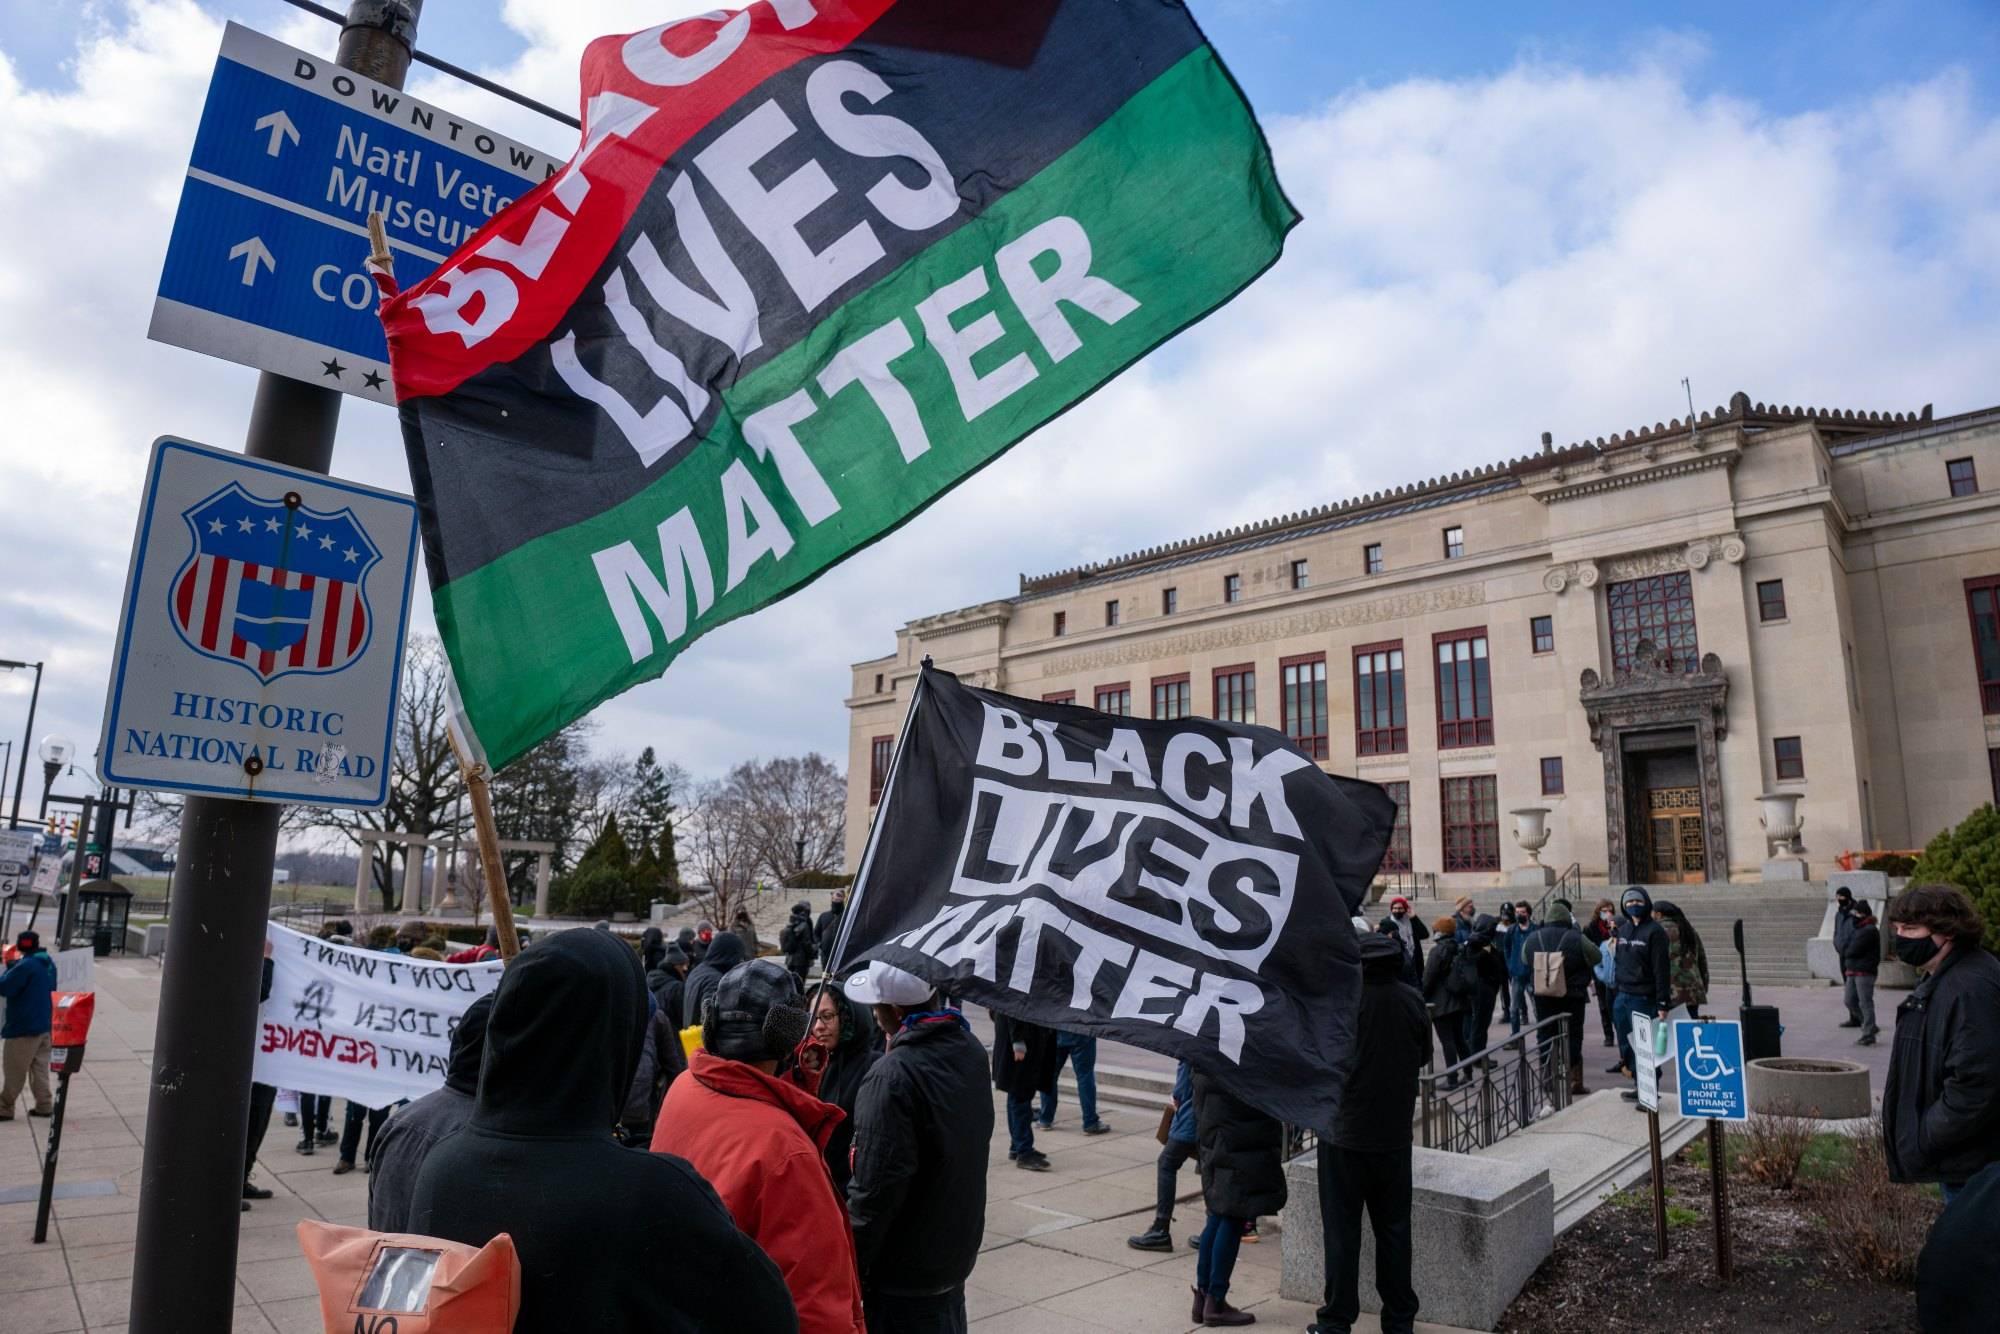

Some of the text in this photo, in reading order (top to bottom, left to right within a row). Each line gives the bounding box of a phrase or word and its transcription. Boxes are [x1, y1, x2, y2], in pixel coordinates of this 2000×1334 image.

[335, 124, 421, 187] Natl
[407, 0, 818, 349] BLAC
[312, 264, 381, 317] CO
[550, 60, 961, 468] LIVES
[591, 216, 1142, 664] MATTER
[171, 692, 344, 736] HISTORIC
[294, 748, 376, 779] RAD
[975, 701, 1312, 841] BLACK
[961, 790, 1281, 950] LIVES
[885, 897, 1265, 1065] MATTER
[1687, 1090, 1737, 1099] FRONT ST.
[1687, 1098, 1737, 1107] ENTRANCE
[1701, 1082, 1721, 1090] USE
